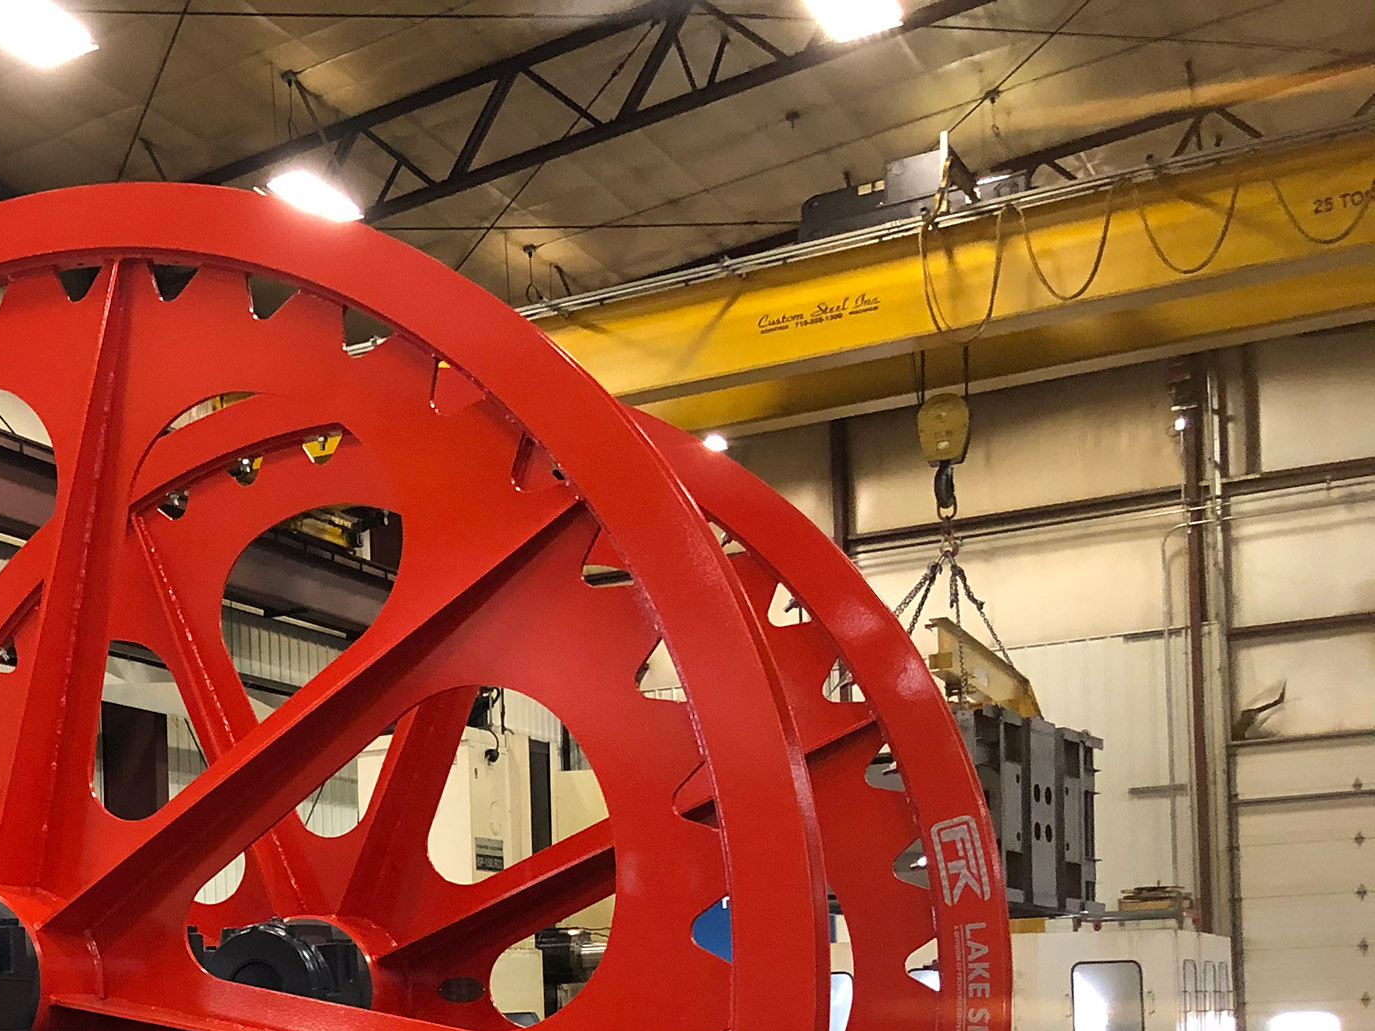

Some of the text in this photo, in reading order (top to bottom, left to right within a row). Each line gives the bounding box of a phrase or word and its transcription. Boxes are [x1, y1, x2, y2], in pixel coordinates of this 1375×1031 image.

[1313, 196, 1333, 214] 25
[757, 314, 804, 329] Custom
[810, 296, 850, 318] Steel
[965, 922, 990, 998] LAKE
